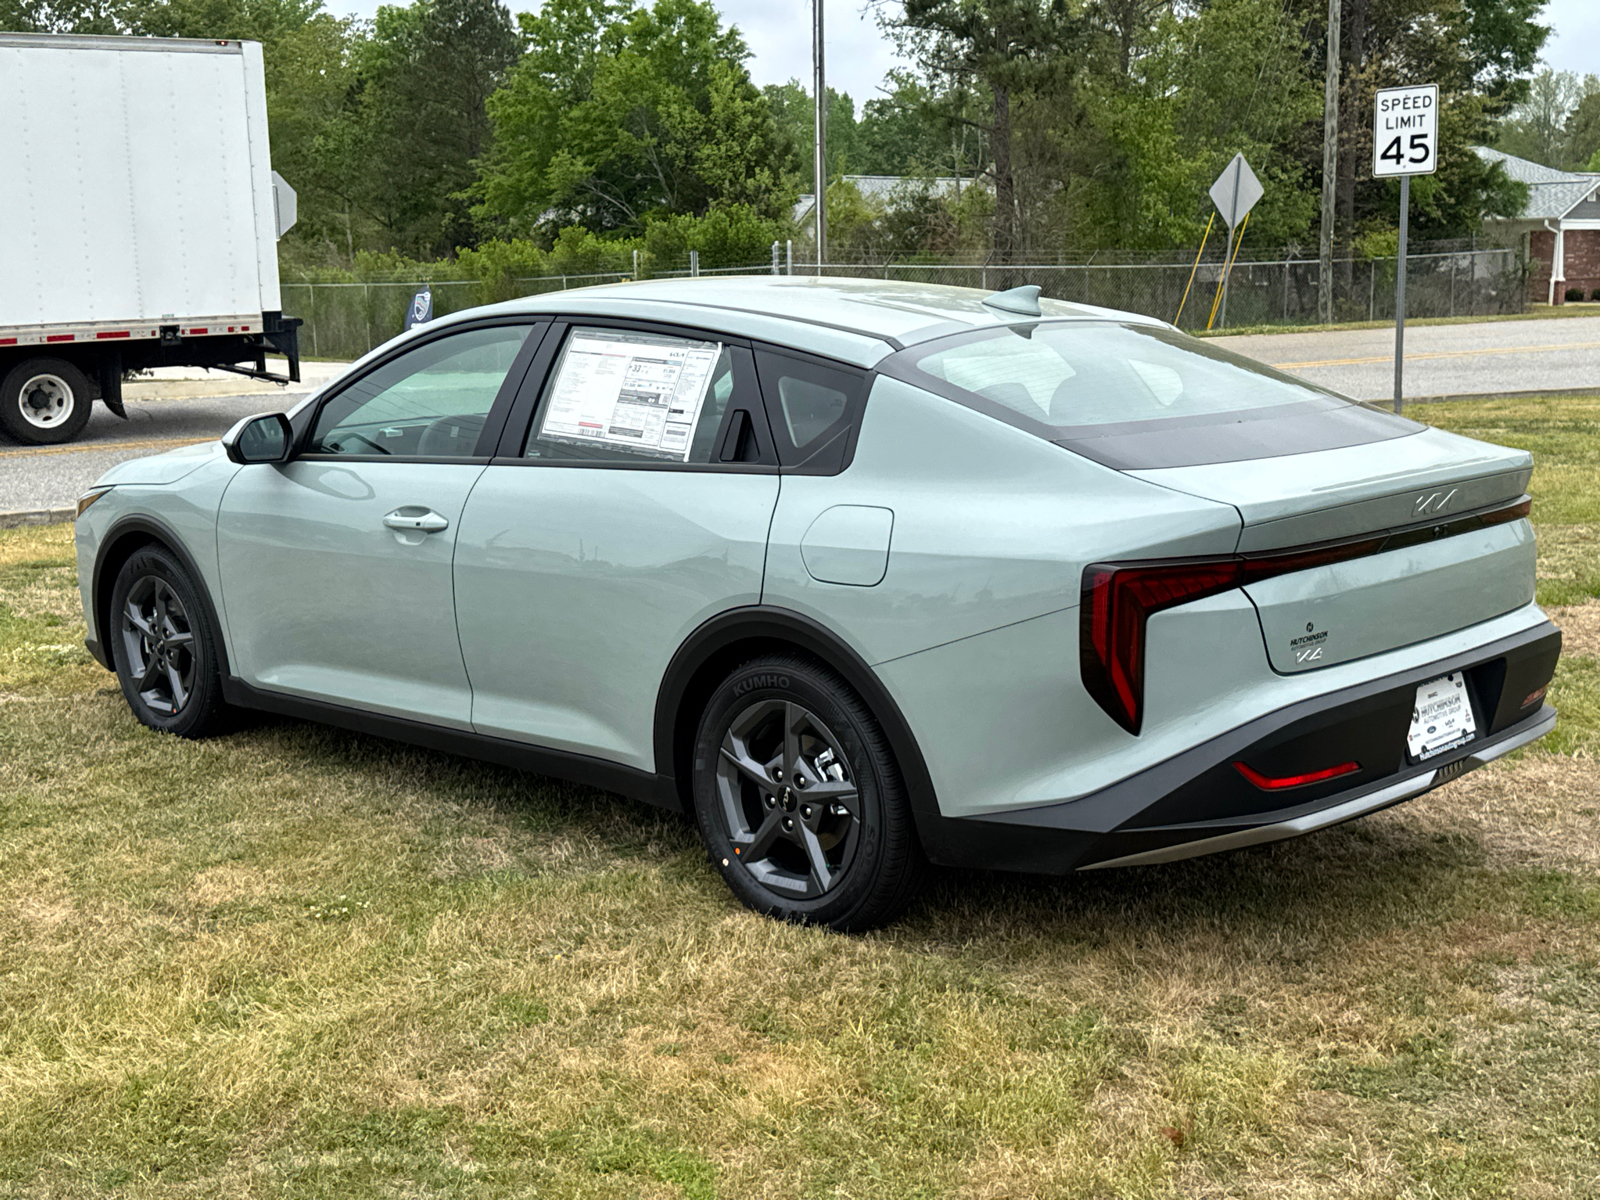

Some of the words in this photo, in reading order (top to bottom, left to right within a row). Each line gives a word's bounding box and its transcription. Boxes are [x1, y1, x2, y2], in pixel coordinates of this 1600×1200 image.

[1381, 95, 1432, 112] SPEED
[1386, 114, 1426, 130] LIMIT
[1380, 133, 1430, 165] 45
[1290, 630, 1329, 646] HUTCHINSON
[1296, 647, 1323, 664] K4
[733, 675, 790, 698] KUMHO
[1420, 692, 1461, 717] HUTCHINSON
[1424, 709, 1448, 724] AUTOMOTIVE
[1448, 704, 1461, 715] GROUP
